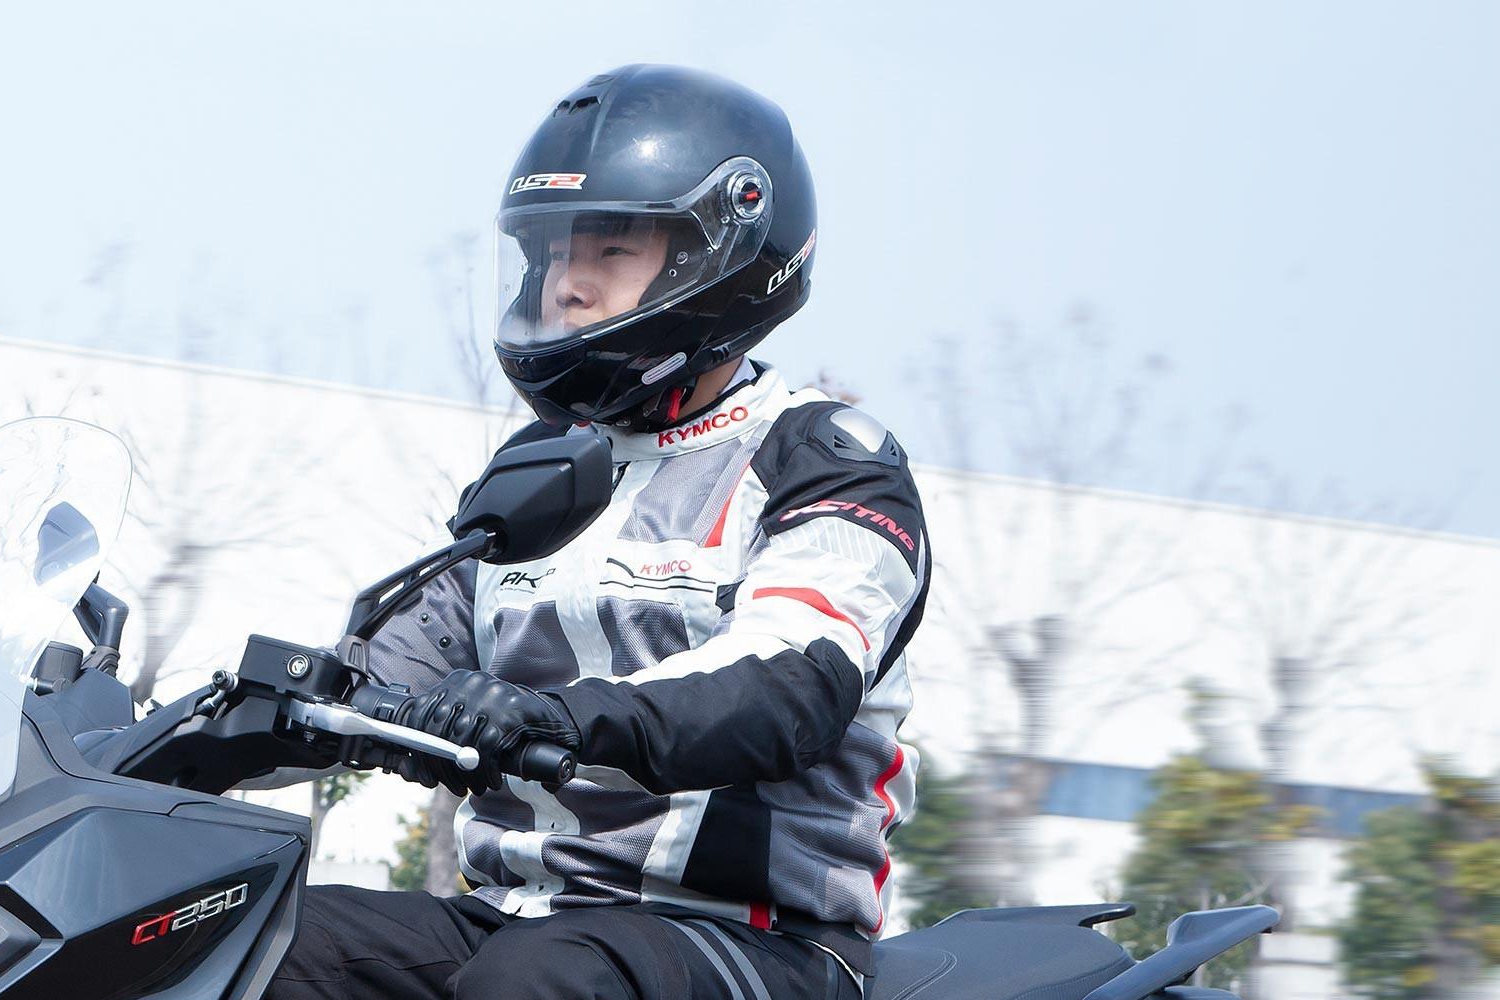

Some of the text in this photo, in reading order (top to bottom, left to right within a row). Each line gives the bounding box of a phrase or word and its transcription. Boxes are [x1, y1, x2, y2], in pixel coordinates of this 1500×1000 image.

[509, 173, 587, 195] LS2
[657, 406, 749, 448] KYMCO
[640, 560, 692, 575] KYMCO
[131, 883, 249, 945] CT250
